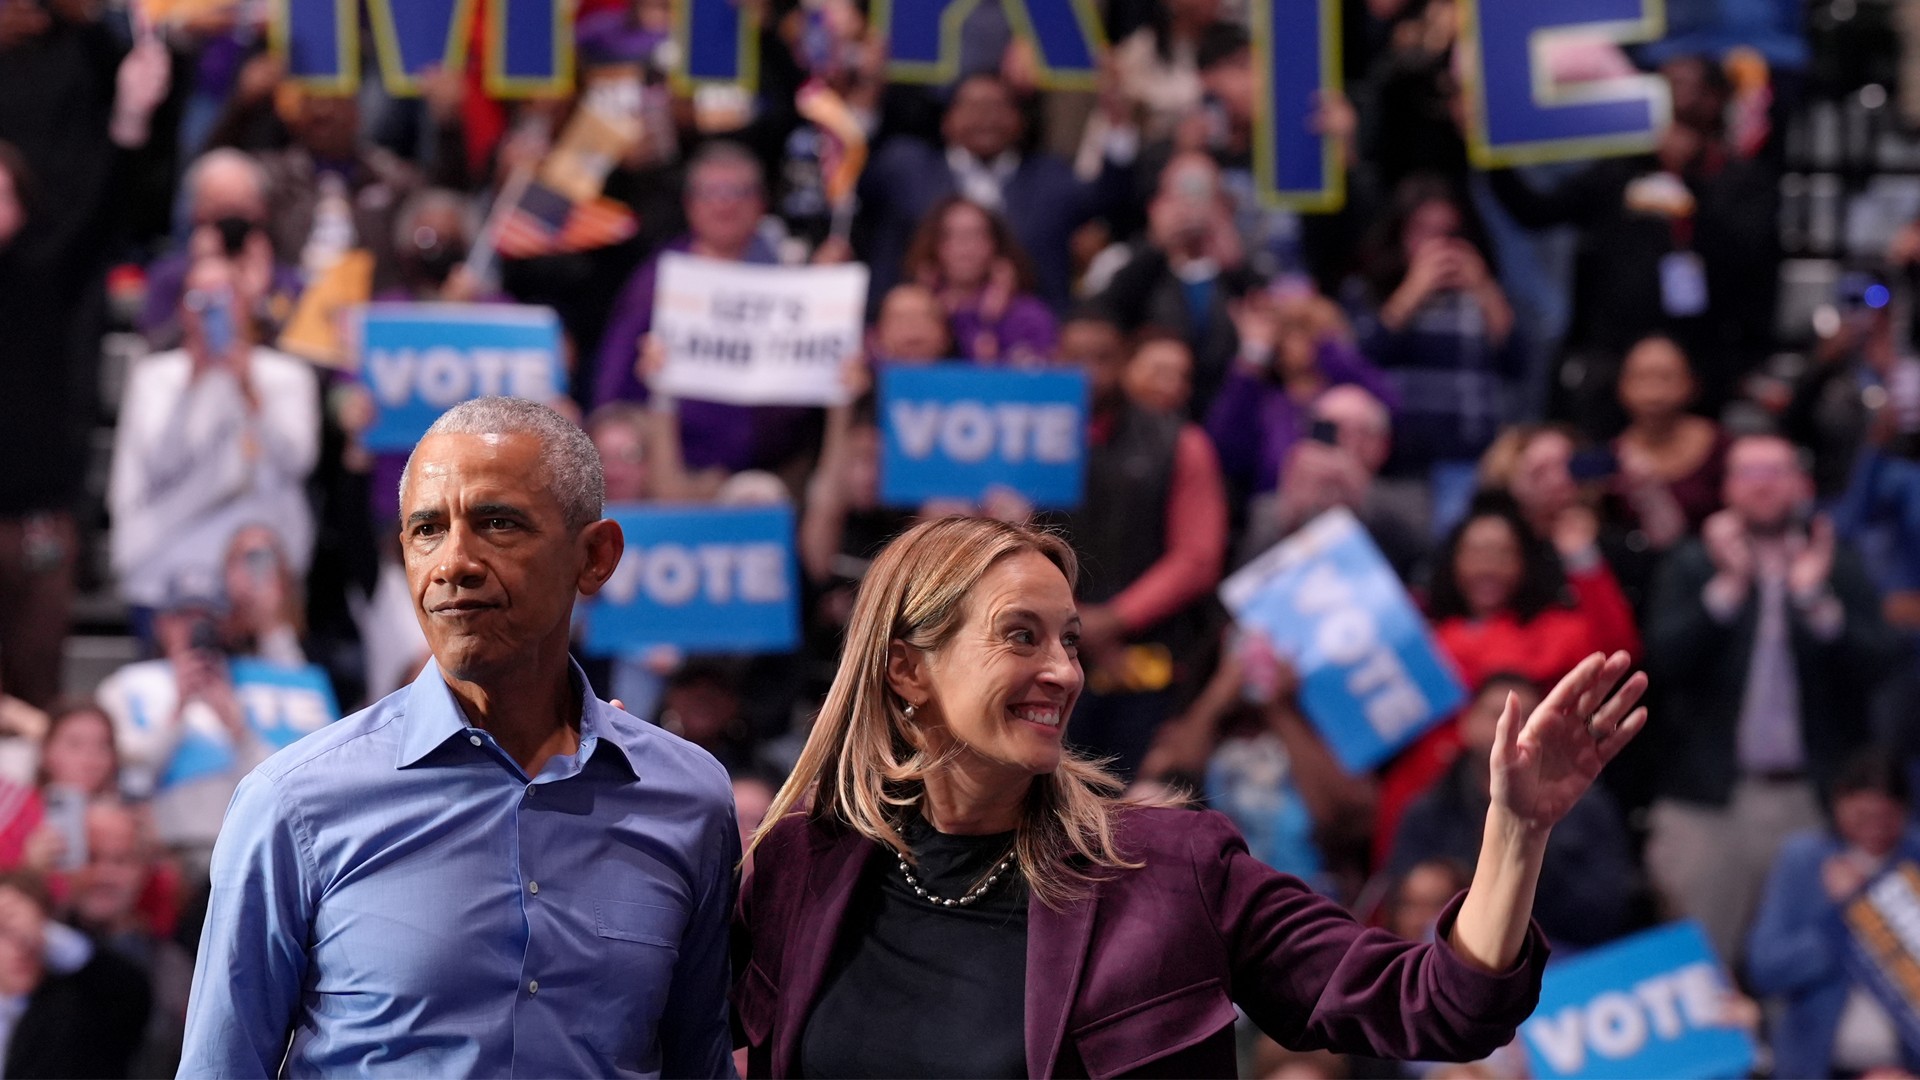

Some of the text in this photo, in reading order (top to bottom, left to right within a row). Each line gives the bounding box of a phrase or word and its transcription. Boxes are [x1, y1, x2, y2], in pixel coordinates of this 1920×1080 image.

[369, 347, 553, 405] VOTE
[888, 401, 1078, 461] VOTE
[1296, 561, 1431, 743] VOTE
